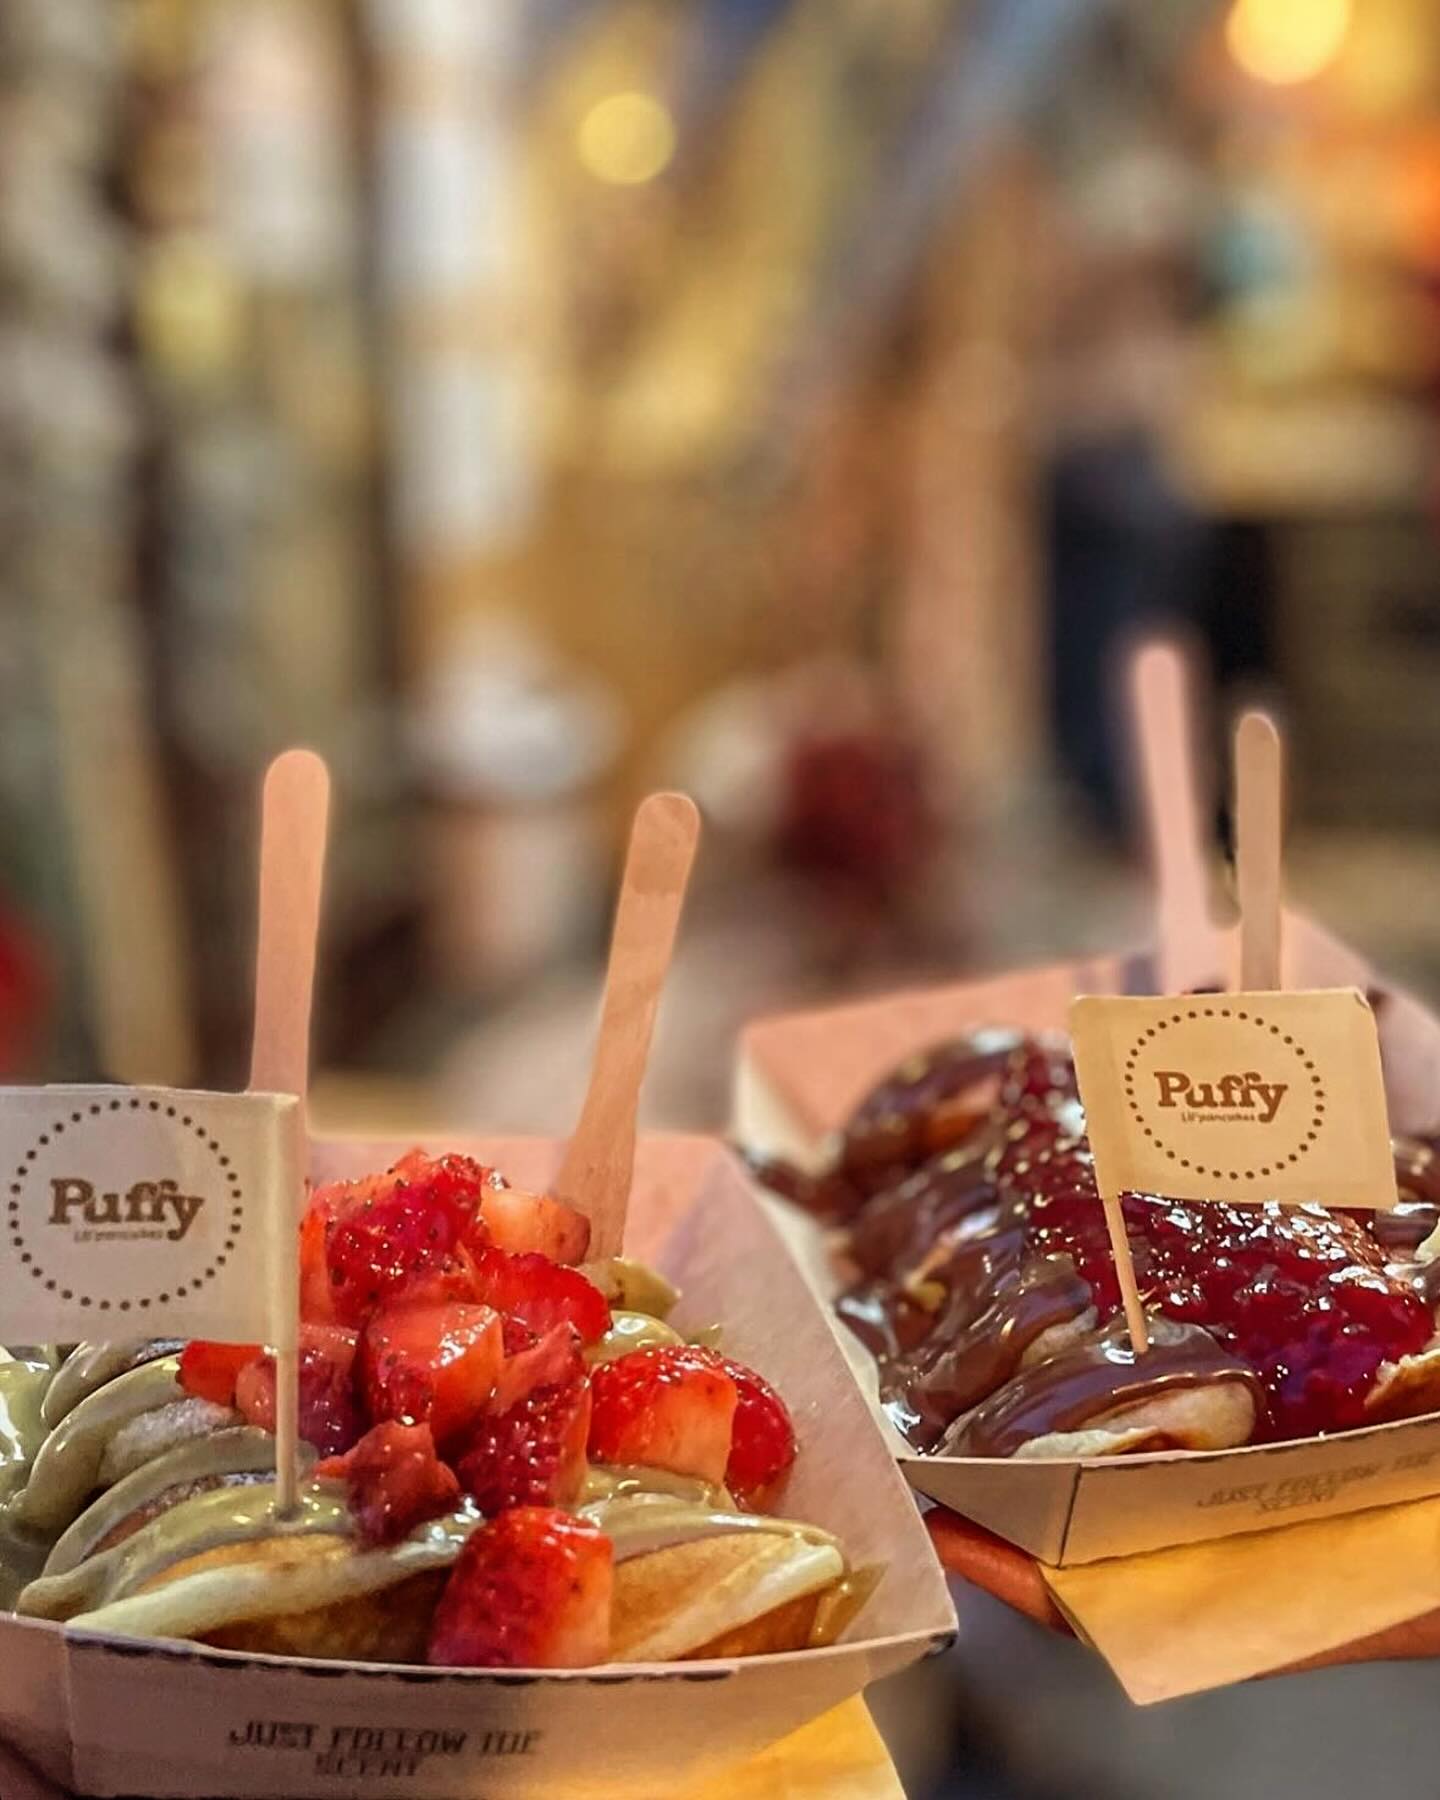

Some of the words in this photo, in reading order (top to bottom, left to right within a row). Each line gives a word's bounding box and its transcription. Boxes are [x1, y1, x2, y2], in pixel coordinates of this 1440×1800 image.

[1154, 1071, 1288, 1123] Puffy
[48, 1178, 205, 1241] Puffy
[228, 1721, 319, 1750] JUST
